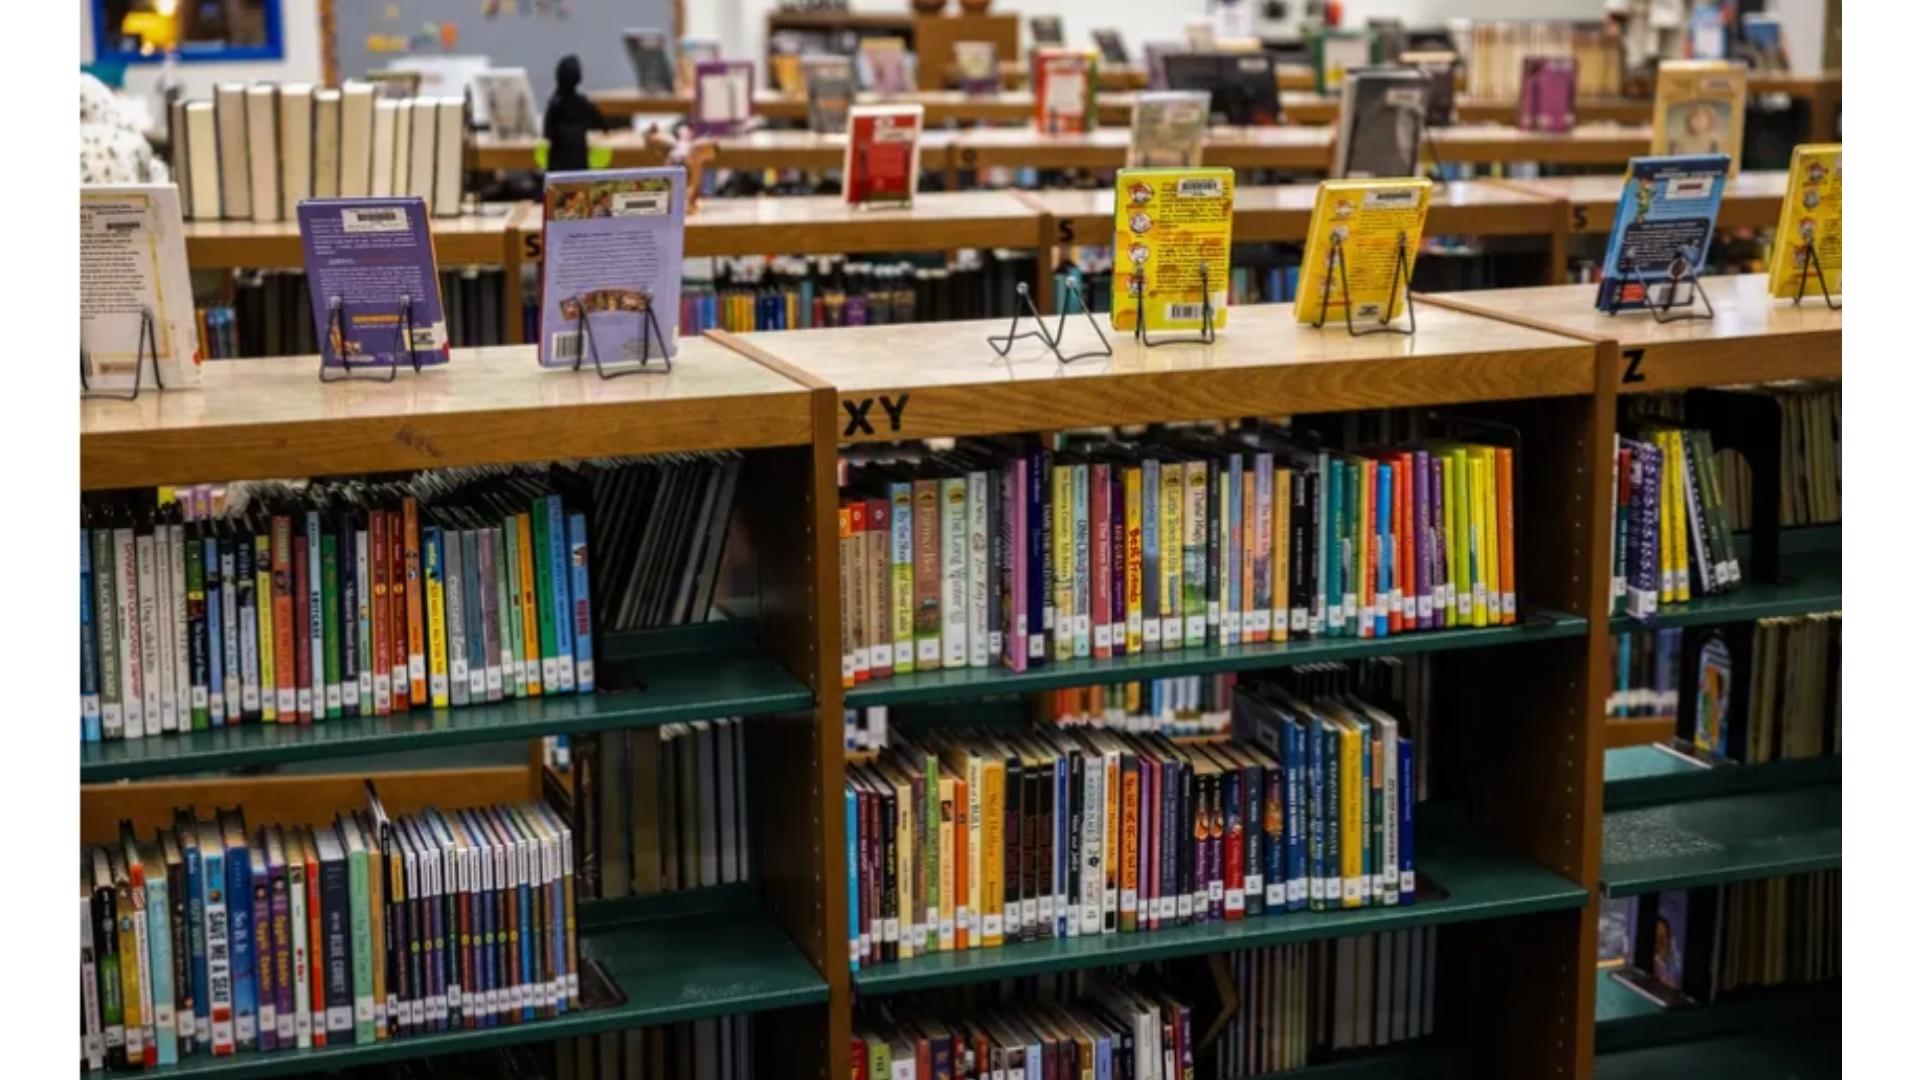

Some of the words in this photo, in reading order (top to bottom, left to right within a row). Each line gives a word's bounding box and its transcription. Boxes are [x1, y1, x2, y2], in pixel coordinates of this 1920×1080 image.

[1059, 219, 1075, 243] S
[525, 233, 541, 258] S
[1621, 348, 1646, 385] Z
[952, 511, 966, 532] The
[950, 535, 967, 565] Long
[1130, 527, 1140, 558] Best
[950, 568, 967, 607] Winter
[1130, 562, 1141, 602] Friends
[311, 591, 320, 640] SUITCASE
[899, 610, 908, 632] Lake
[1126, 778, 1137, 889] FEARLES
[208, 911, 225, 942] SAVE
[233, 911, 247, 927] So
[210, 944, 226, 960] ME
[330, 934, 345, 959] BLUE
[212, 965, 227, 973] A
[212, 977, 228, 1003] SEAT
